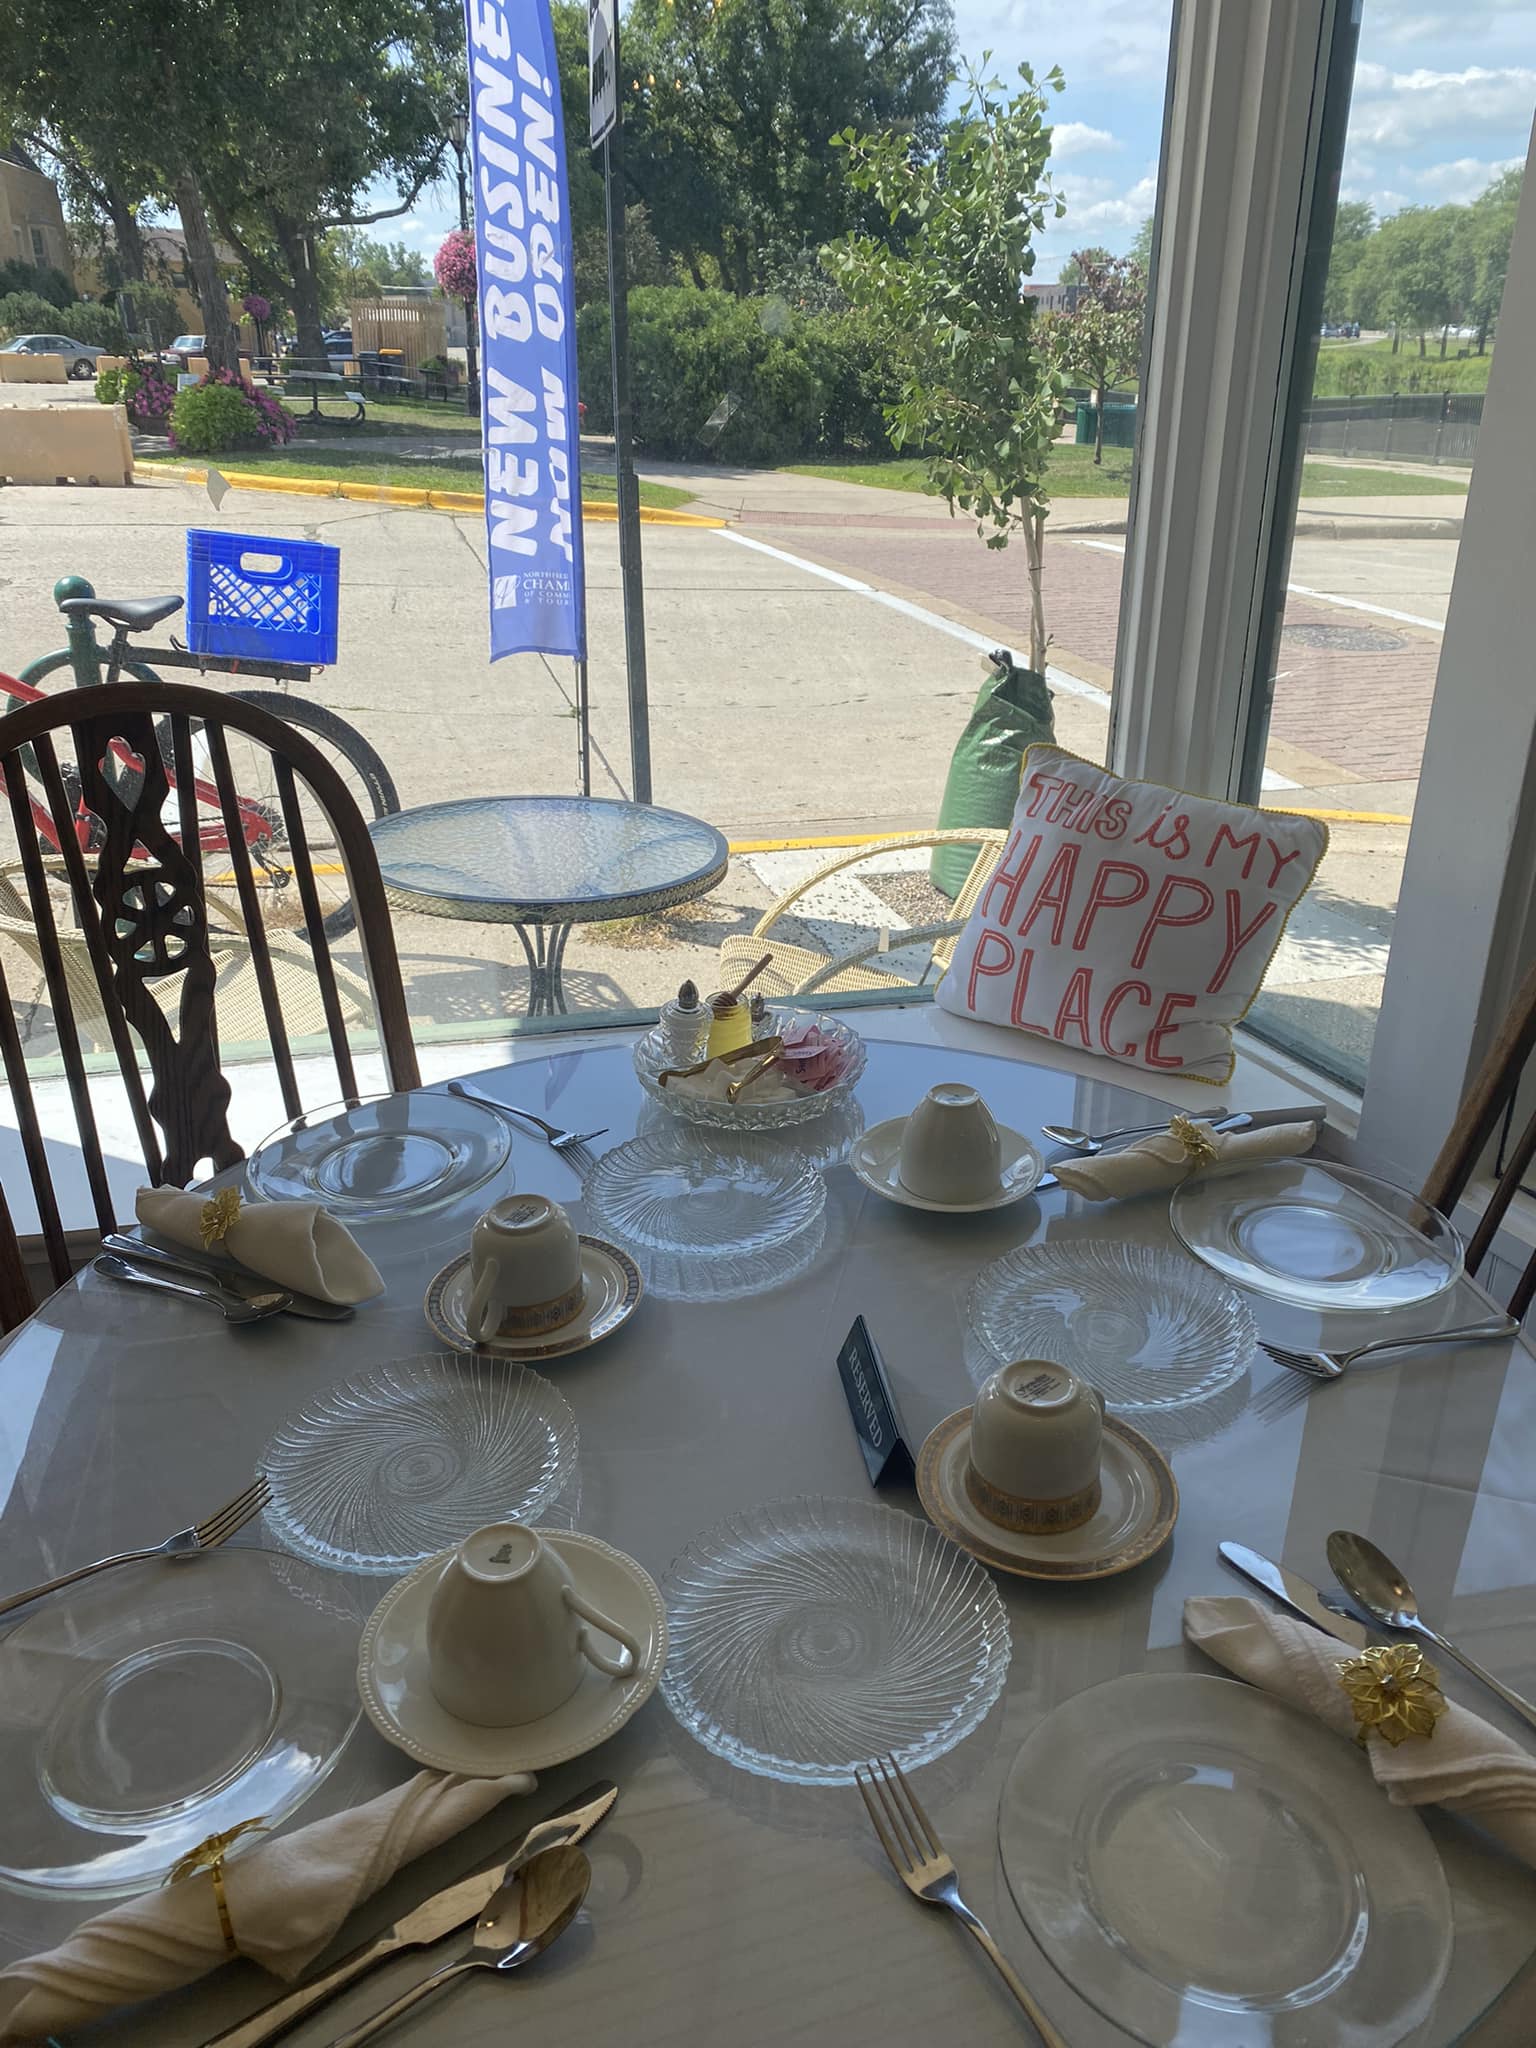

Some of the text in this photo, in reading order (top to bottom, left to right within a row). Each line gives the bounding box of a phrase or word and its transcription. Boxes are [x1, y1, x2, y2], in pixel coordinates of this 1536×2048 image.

[517, 53, 565, 342] OPEN!
[470, 0, 539, 557] NEW BUSINE
[1026, 772, 1300, 889] THIS is MY
[982, 830, 1277, 994] HAPPY
[967, 928, 1197, 1068] PLACE
[848, 1348, 883, 1448] RESERVED
